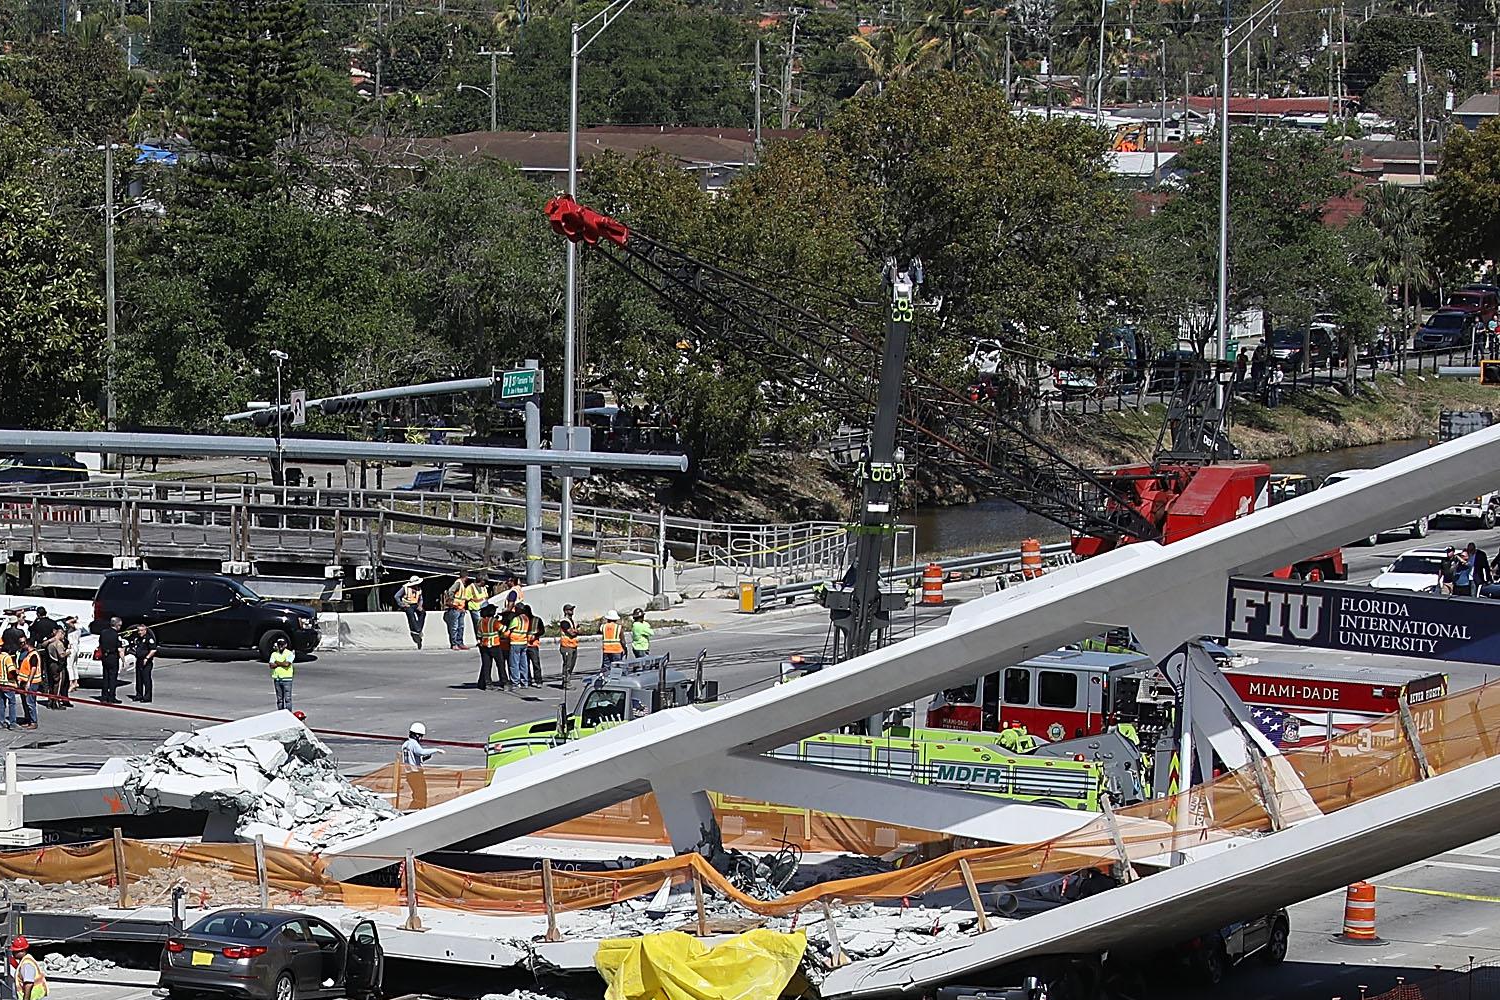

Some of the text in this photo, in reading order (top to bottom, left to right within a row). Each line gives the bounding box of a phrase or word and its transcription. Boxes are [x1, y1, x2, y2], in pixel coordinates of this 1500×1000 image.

[1230, 587, 1323, 641] FIU
[1340, 597, 1410, 617] FLORIDA
[1339, 614, 1472, 640] INTERNATIONAL
[1339, 631, 1438, 653] UNIVERSITY
[1249, 682, 1340, 701] MIAMI-DADE
[937, 764, 1002, 785] MDFR
